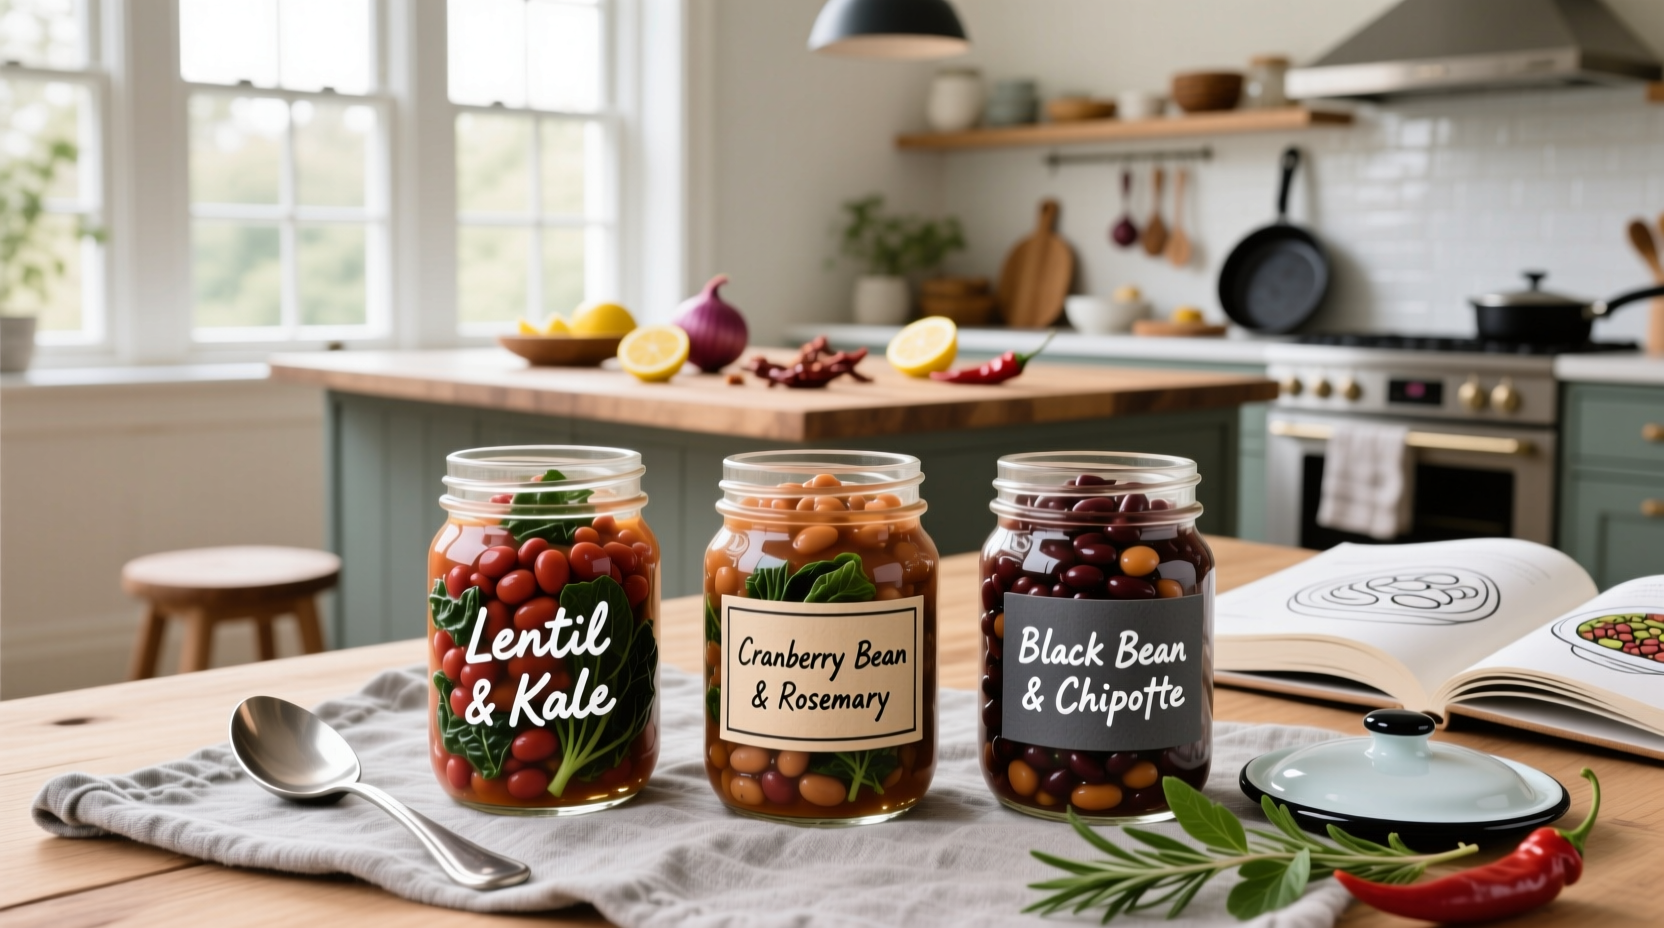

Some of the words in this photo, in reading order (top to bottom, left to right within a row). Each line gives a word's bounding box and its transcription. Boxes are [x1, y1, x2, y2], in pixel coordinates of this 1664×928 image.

[465, 600, 611, 664] Lentil
[1018, 625, 1104, 667] Black
[1115, 629, 1187, 669] Bean
[738, 636, 845, 682] Cranberry
[854, 639, 907, 670] Bean
[464, 678, 496, 727] &
[508, 667, 617, 728] Kale
[751, 679, 769, 710] &
[778, 681, 890, 722] Rosemary
[1021, 675, 1045, 713] &
